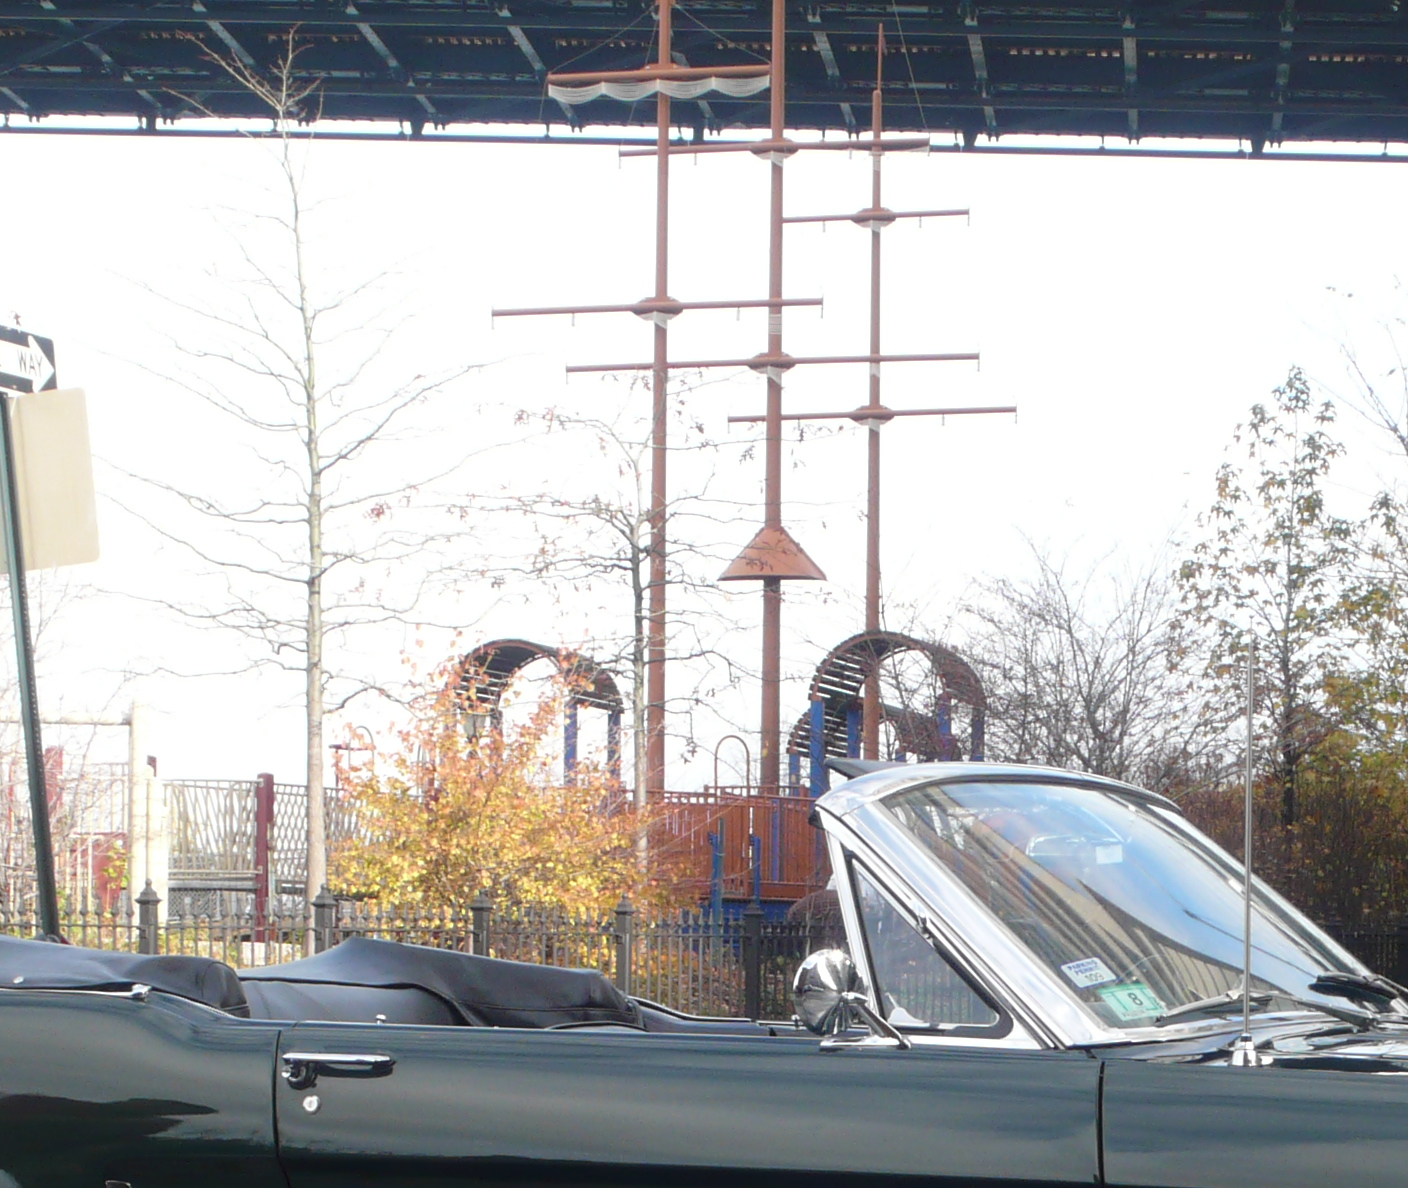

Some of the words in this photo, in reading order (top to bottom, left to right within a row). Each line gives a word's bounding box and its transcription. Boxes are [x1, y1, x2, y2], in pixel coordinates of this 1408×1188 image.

[17, 349, 42, 377] WAY
[1067, 960, 1098, 971] PARKING
[1127, 992, 1143, 1006] 8
